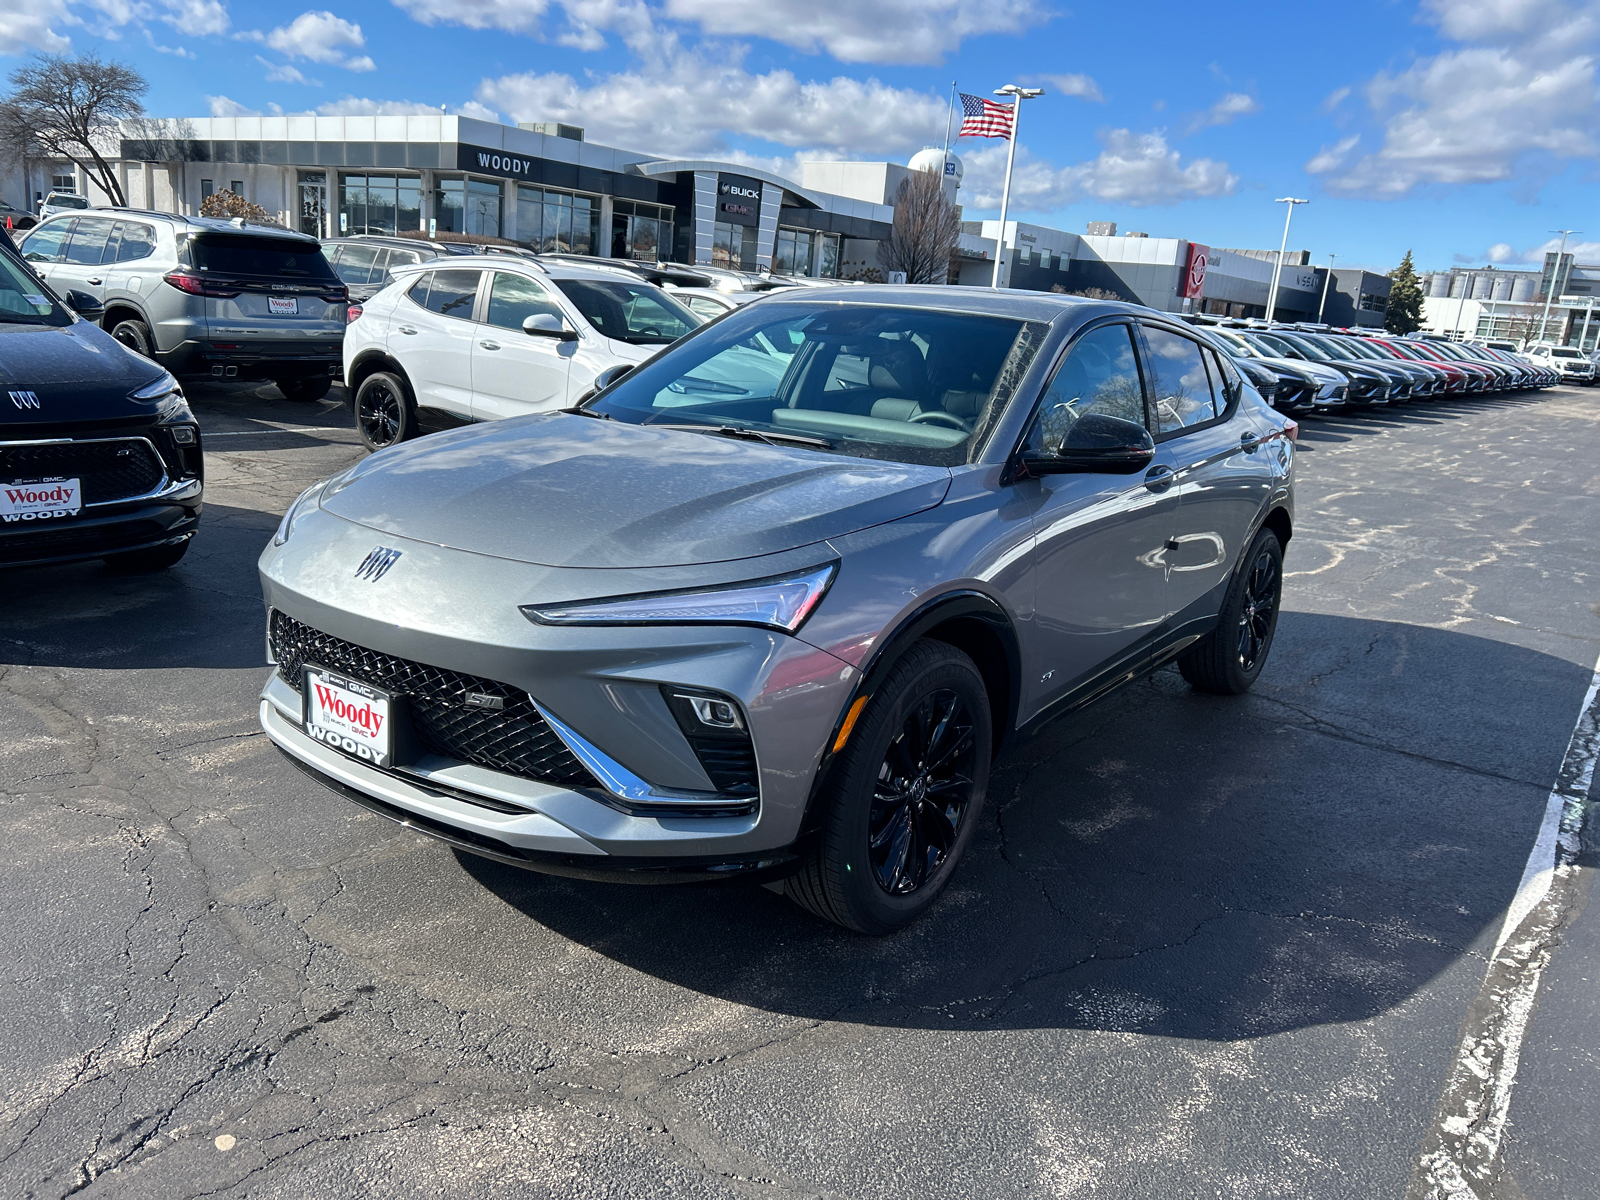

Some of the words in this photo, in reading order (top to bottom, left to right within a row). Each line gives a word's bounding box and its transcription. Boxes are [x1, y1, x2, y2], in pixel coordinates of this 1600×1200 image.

[478, 153, 530, 174] WOODY
[731, 186, 759, 199] BUICK
[724, 203, 754, 216] GMC
[1296, 275, 1319, 288] NISSAN
[271, 300, 295, 309] Woody
[4, 485, 75, 505] Woody
[2, 508, 80, 522] WOODY
[349, 682, 371, 697] GMC
[467, 692, 503, 709] ST
[314, 683, 384, 738] Woody
[306, 721, 388, 765] WOODY
